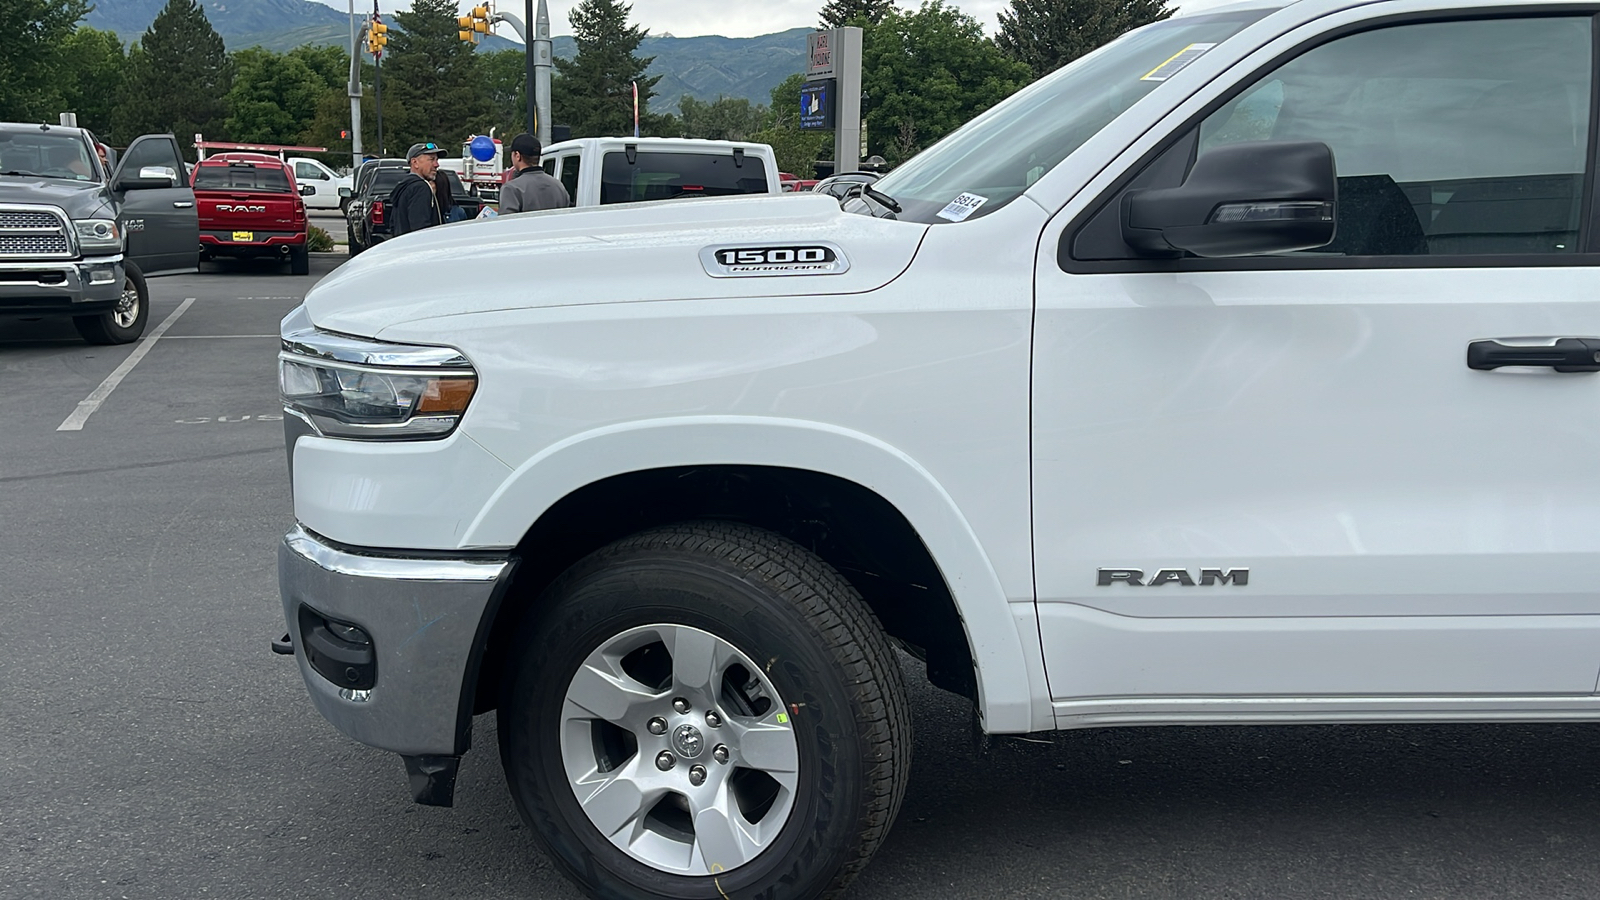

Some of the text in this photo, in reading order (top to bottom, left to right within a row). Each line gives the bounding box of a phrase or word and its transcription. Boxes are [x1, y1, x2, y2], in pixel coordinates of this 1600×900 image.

[216, 204, 266, 213] RAM
[721, 249, 826, 264] 1500
[1096, 567, 1250, 586] RAM
